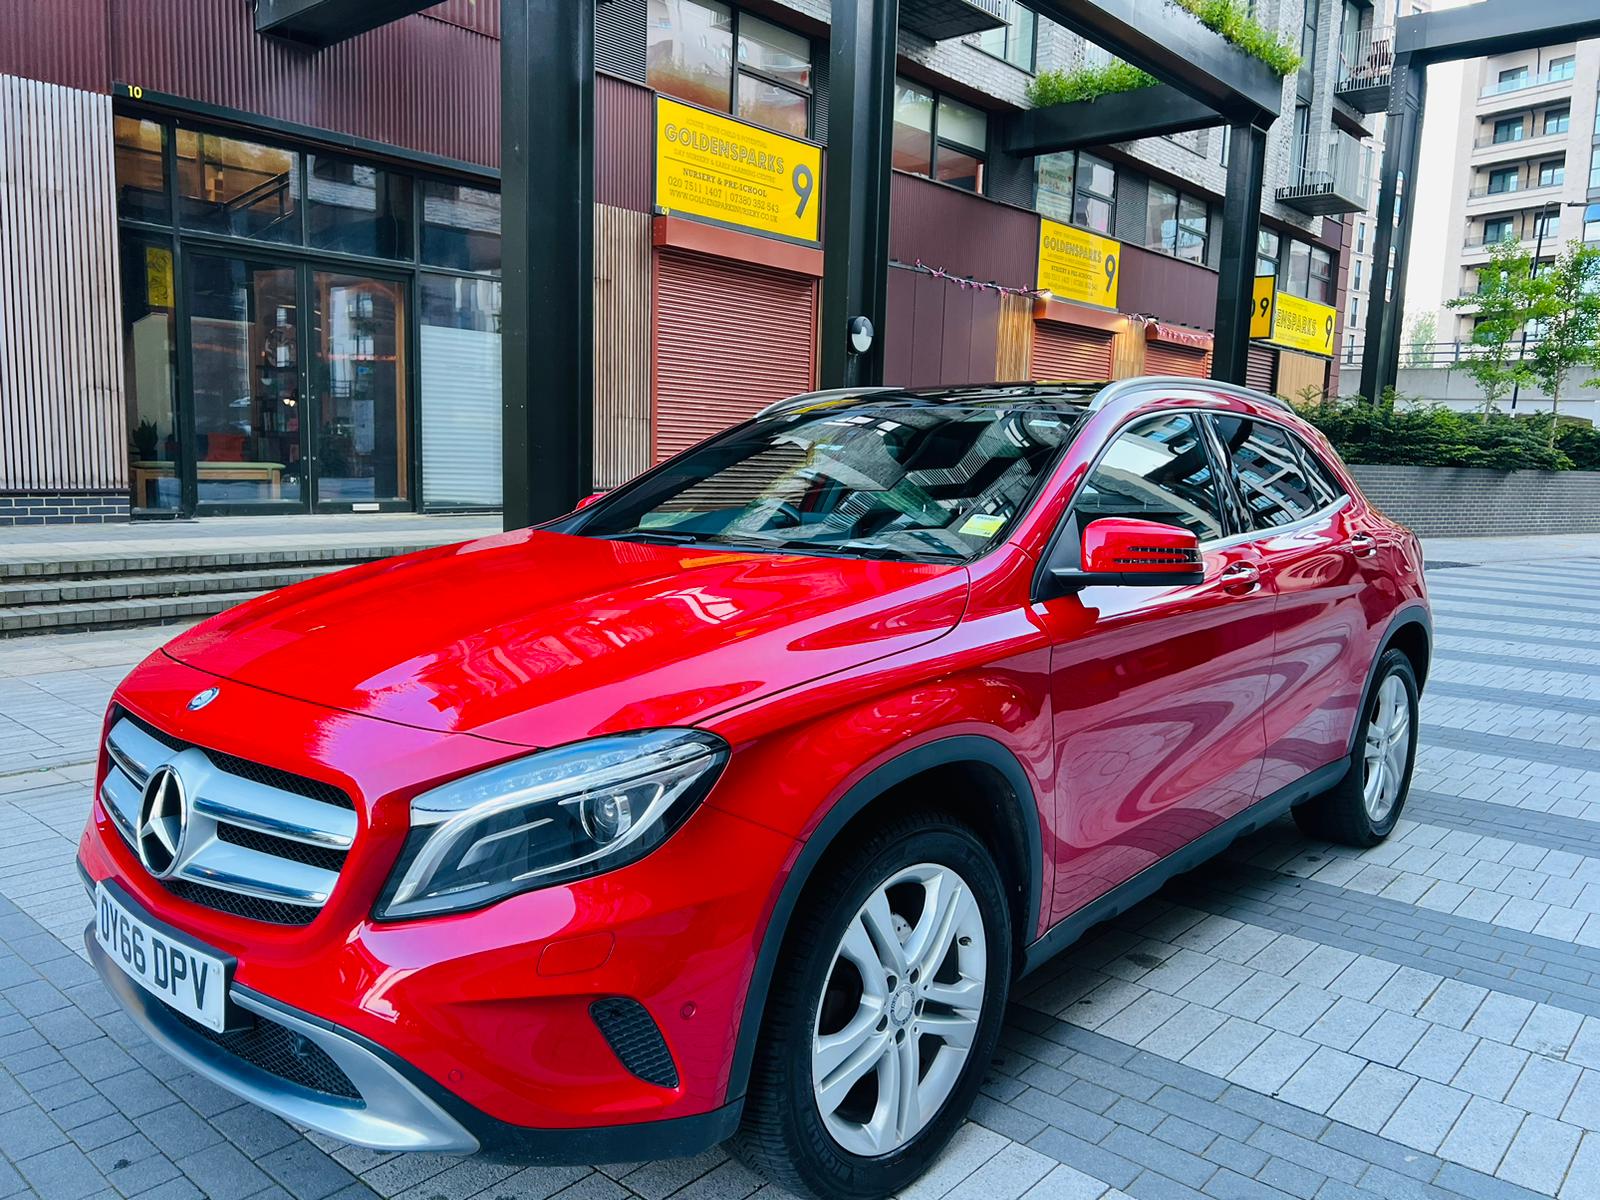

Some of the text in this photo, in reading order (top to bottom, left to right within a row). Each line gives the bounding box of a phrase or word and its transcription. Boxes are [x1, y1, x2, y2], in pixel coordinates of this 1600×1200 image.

[127, 84, 143, 99] 10
[664, 122, 785, 175] GOLDENSPARKS
[667, 175, 683, 188] 020
[684, 179, 702, 194] 7511
[704, 185, 722, 199] 1407
[729, 191, 752, 207] 07380
[766, 202, 780, 214] 543
[682, 167, 716, 184] NURSERY
[716, 177, 723, 185] &
[791, 163, 814, 220] 9
[1105, 254, 1117, 294] 9
[1325, 314, 1333, 349] 9
[101, 895, 209, 1012] OY66 DPV
